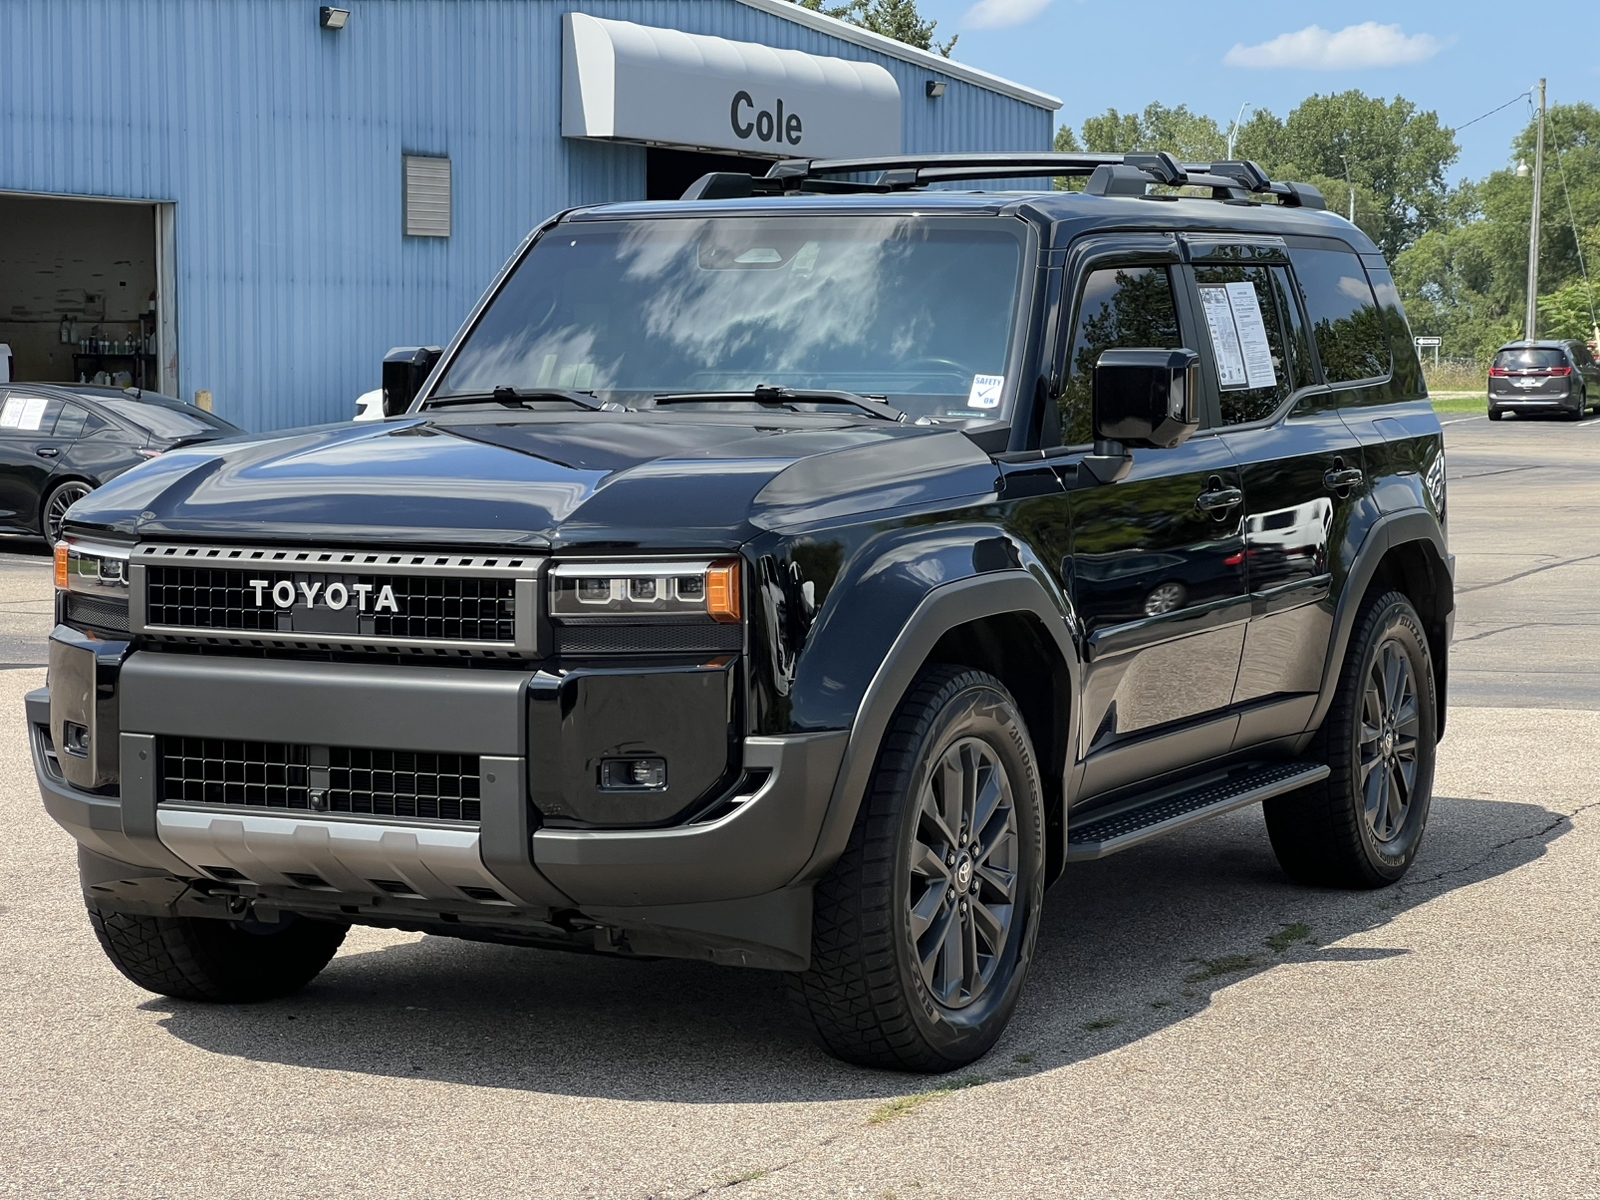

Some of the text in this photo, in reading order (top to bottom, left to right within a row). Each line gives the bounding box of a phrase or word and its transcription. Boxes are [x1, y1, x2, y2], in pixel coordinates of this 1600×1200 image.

[731, 90, 802, 145] Cole
[975, 377, 1002, 386] SAFETY
[249, 580, 399, 612] TOYOTA
[1399, 616, 1427, 657] BLIZZAK
[1008, 725, 1041, 858] BRIDGESTONE
